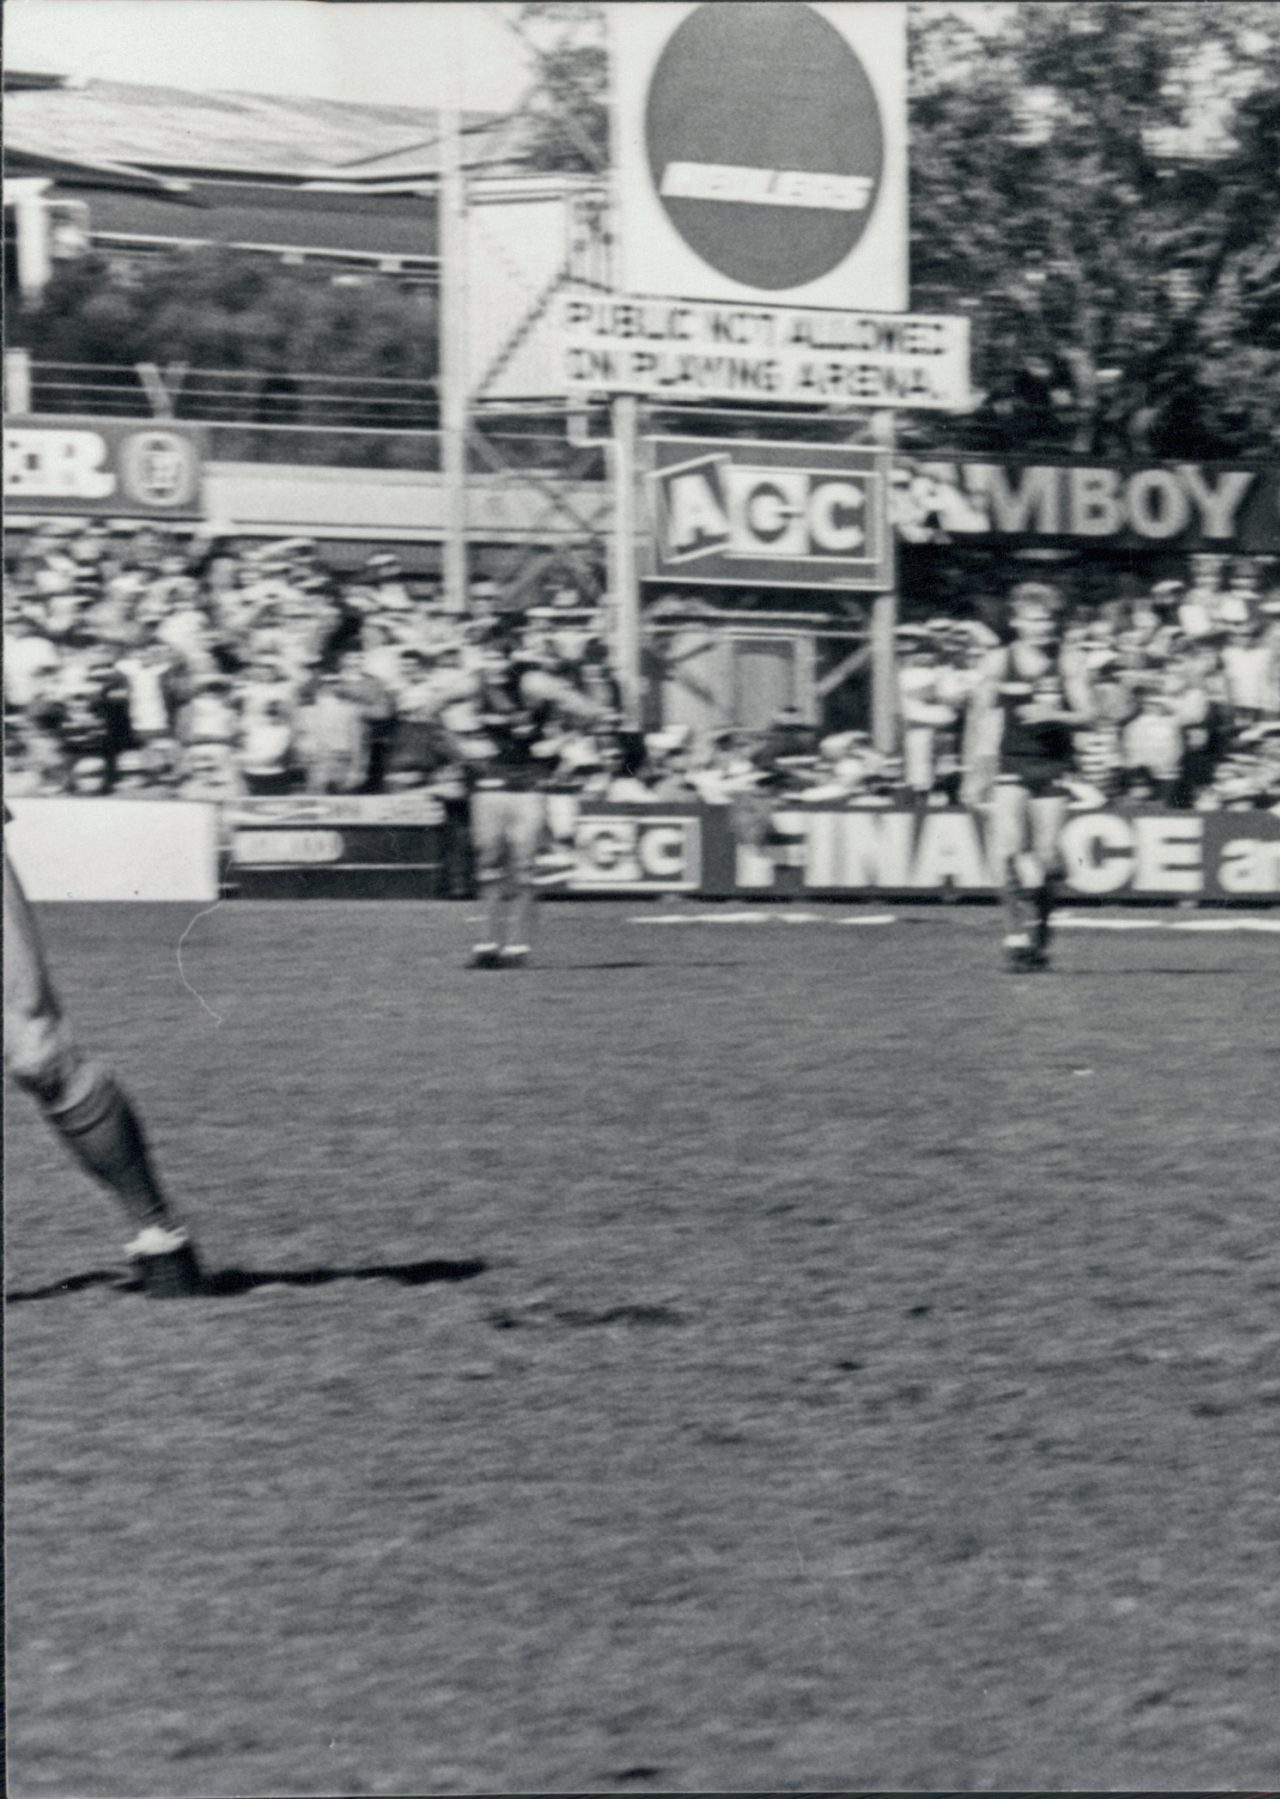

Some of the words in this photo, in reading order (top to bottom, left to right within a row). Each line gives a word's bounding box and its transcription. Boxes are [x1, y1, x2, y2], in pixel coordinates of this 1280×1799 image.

[567, 300, 692, 341] PUBLIC
[706, 308, 777, 348] NOT
[788, 315, 947, 357] ALLOWED
[567, 346, 618, 385] ON
[630, 350, 779, 394] PLAYING
[797, 360, 942, 401] ARENA
[667, 471, 867, 554] AGC
[575, 823, 692, 879] GC
